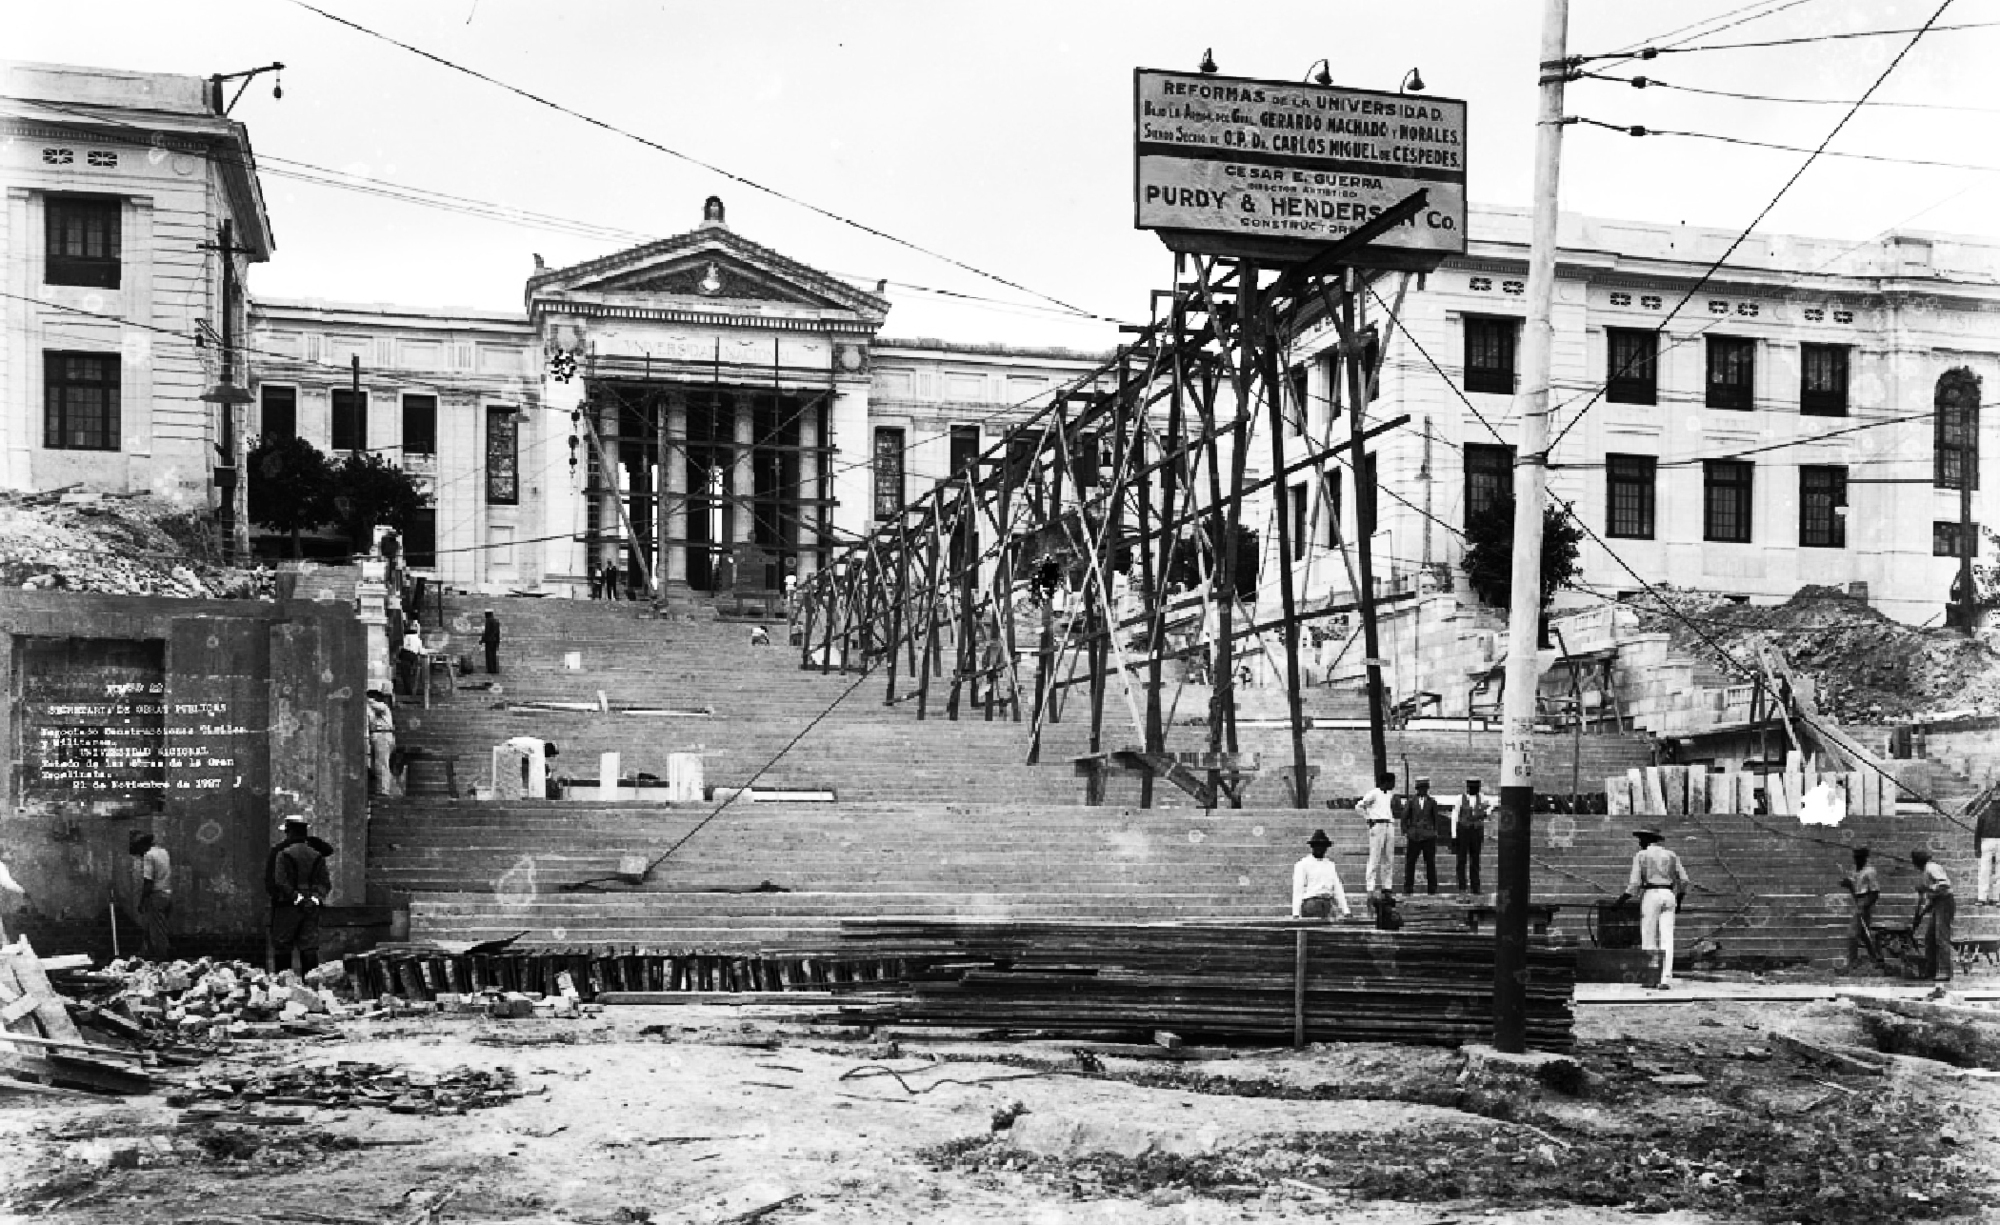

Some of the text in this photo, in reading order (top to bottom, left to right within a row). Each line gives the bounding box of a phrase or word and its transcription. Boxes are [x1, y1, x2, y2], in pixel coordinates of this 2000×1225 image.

[1164, 79, 1266, 103] REFORMAS
[1259, 111, 1322, 132] GERARDO
[1326, 117, 1388, 137] MACHADO
[1272, 134, 1326, 154] CARLOS
[1329, 138, 1379, 160] MIGUEL
[1224, 165, 1284, 181] CESAR
[1292, 171, 1308, 183] E.
[1146, 185, 1227, 209] PURDY
[1240, 193, 1256, 213] &
[1427, 210, 1457, 231] Co.
